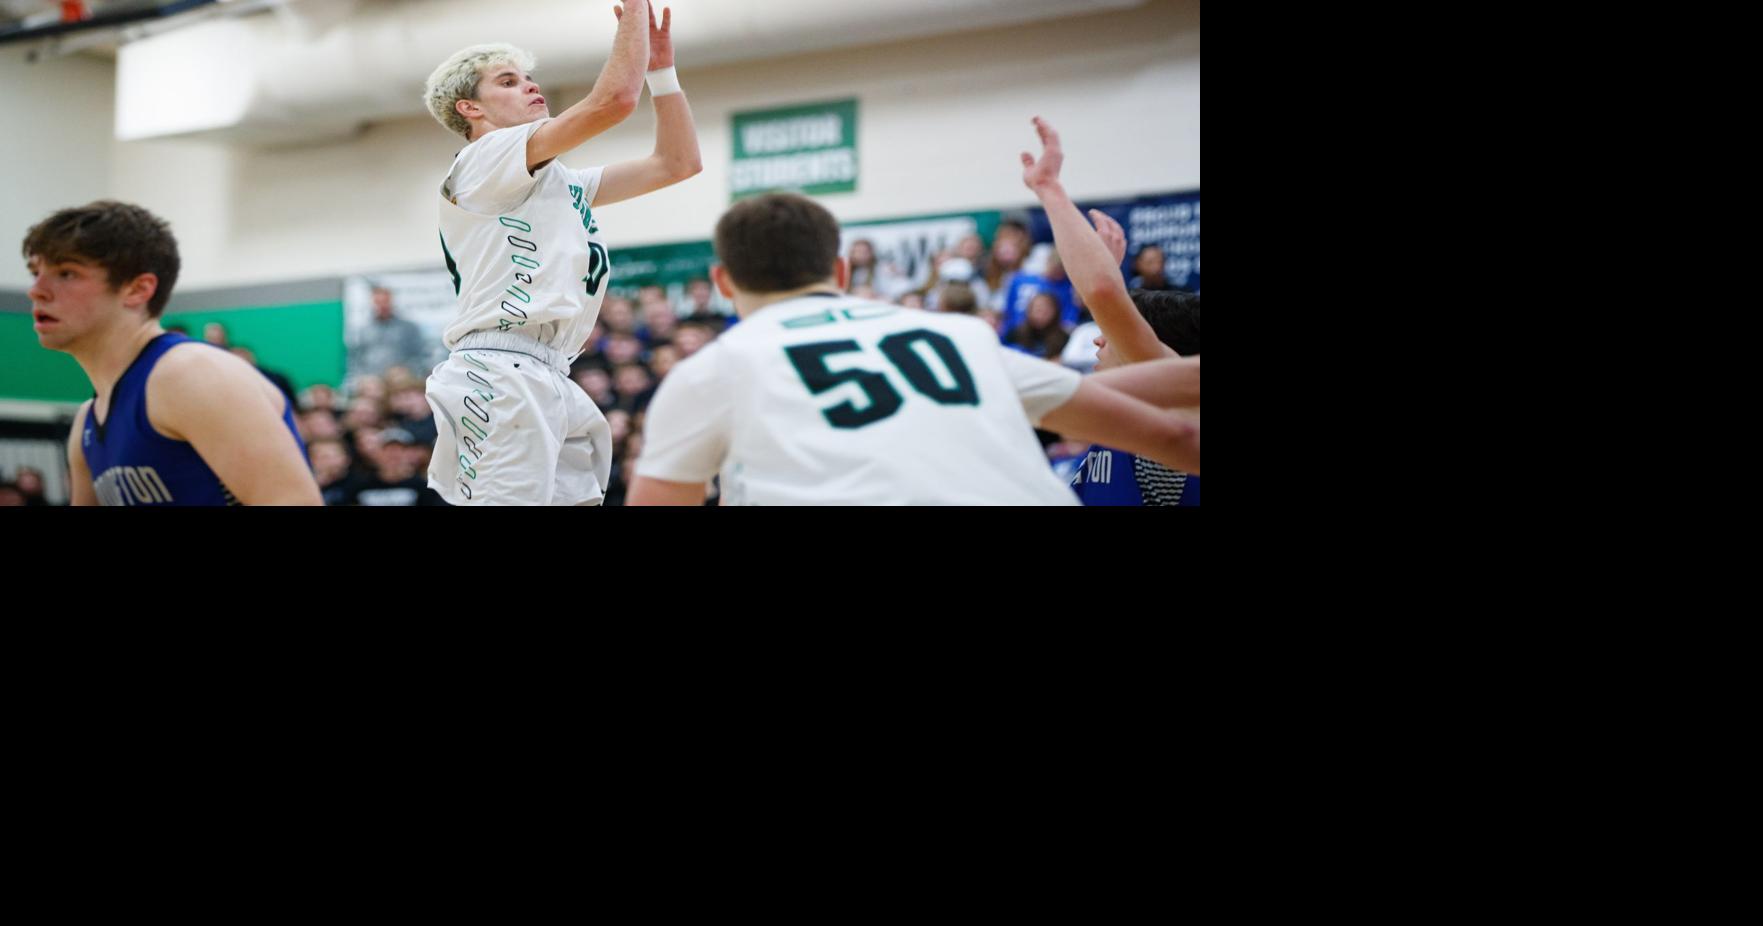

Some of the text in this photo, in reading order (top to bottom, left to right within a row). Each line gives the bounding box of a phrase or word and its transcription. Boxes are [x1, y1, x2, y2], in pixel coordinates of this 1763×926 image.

[742, 113, 841, 153] VISITOR
[732, 148, 855, 191] STUDENTS
[783, 327, 980, 430] 50
